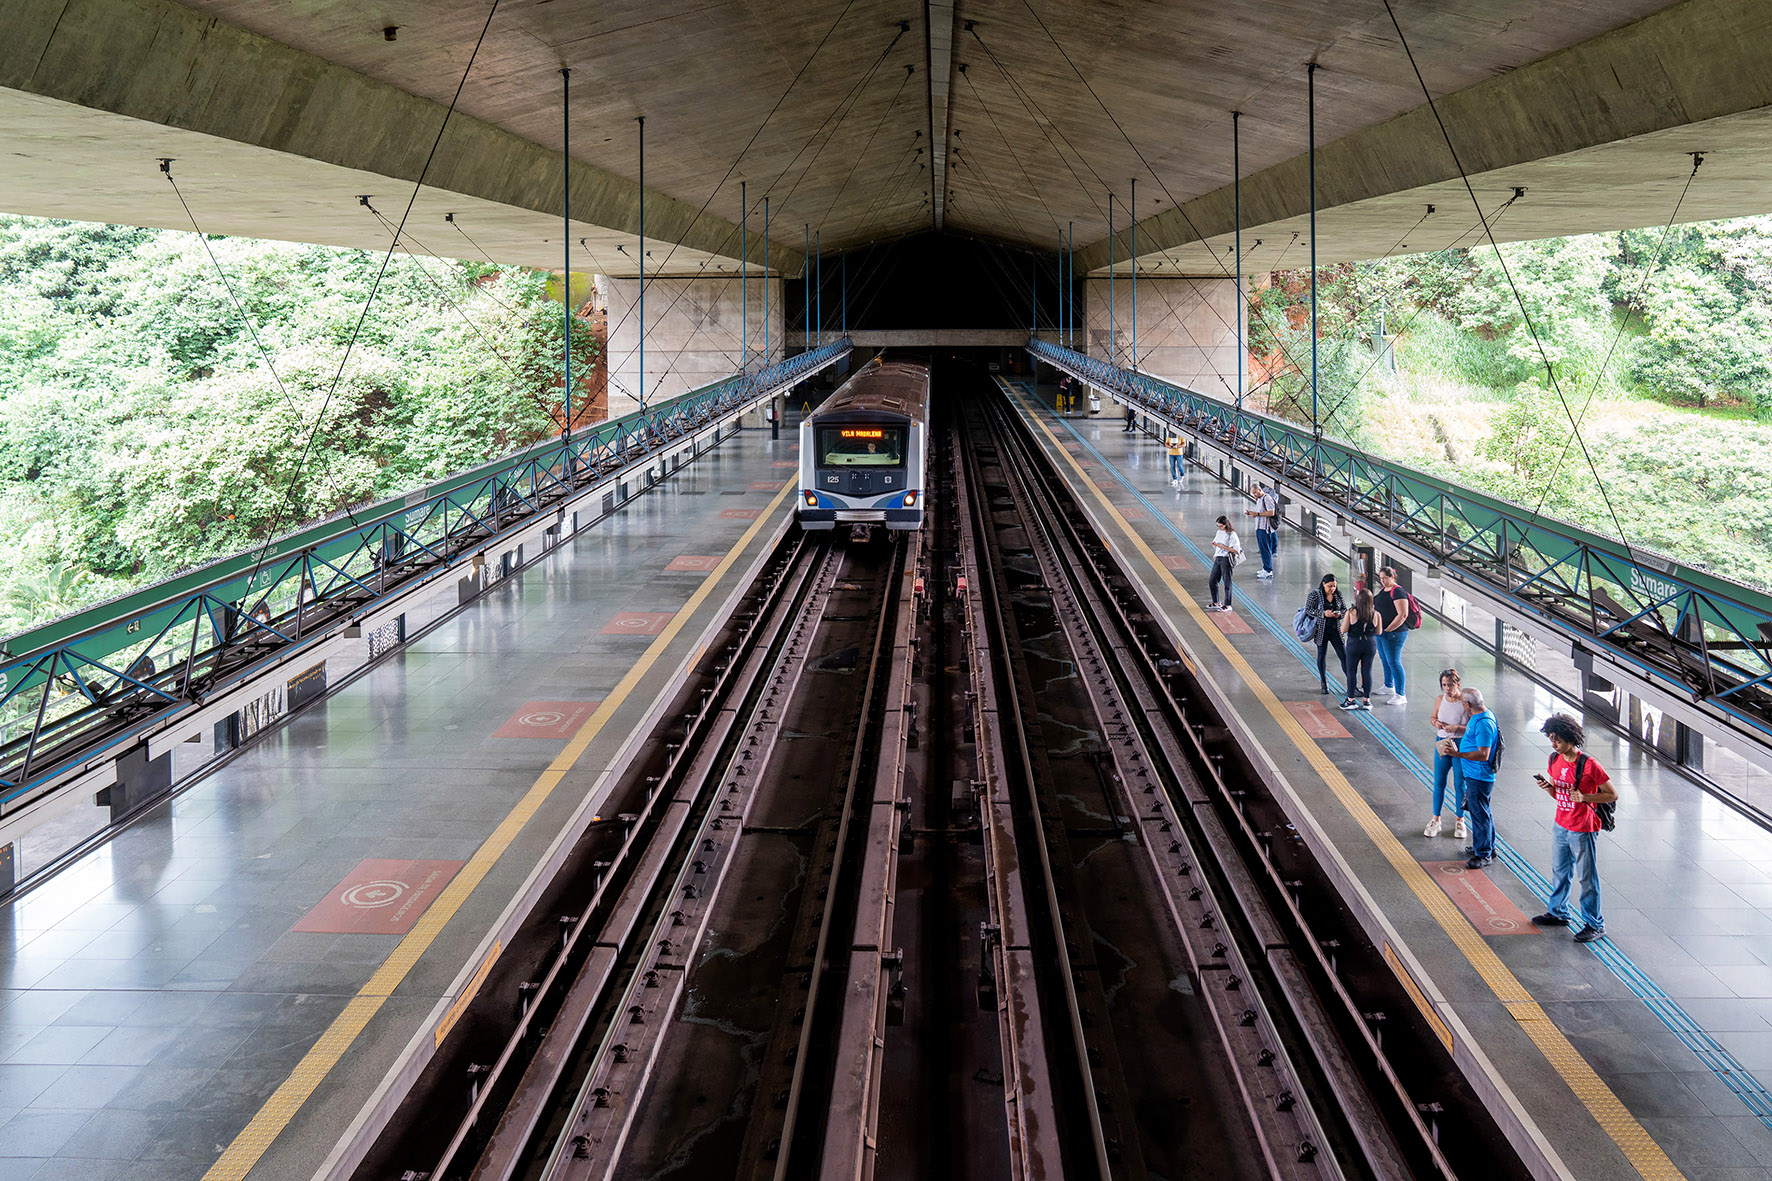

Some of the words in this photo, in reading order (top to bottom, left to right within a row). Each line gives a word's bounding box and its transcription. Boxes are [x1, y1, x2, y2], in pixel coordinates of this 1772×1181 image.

[841, 430, 855, 438] VILA
[827, 475, 840, 484] 125
[1630, 567, 1678, 598] Sumaré
